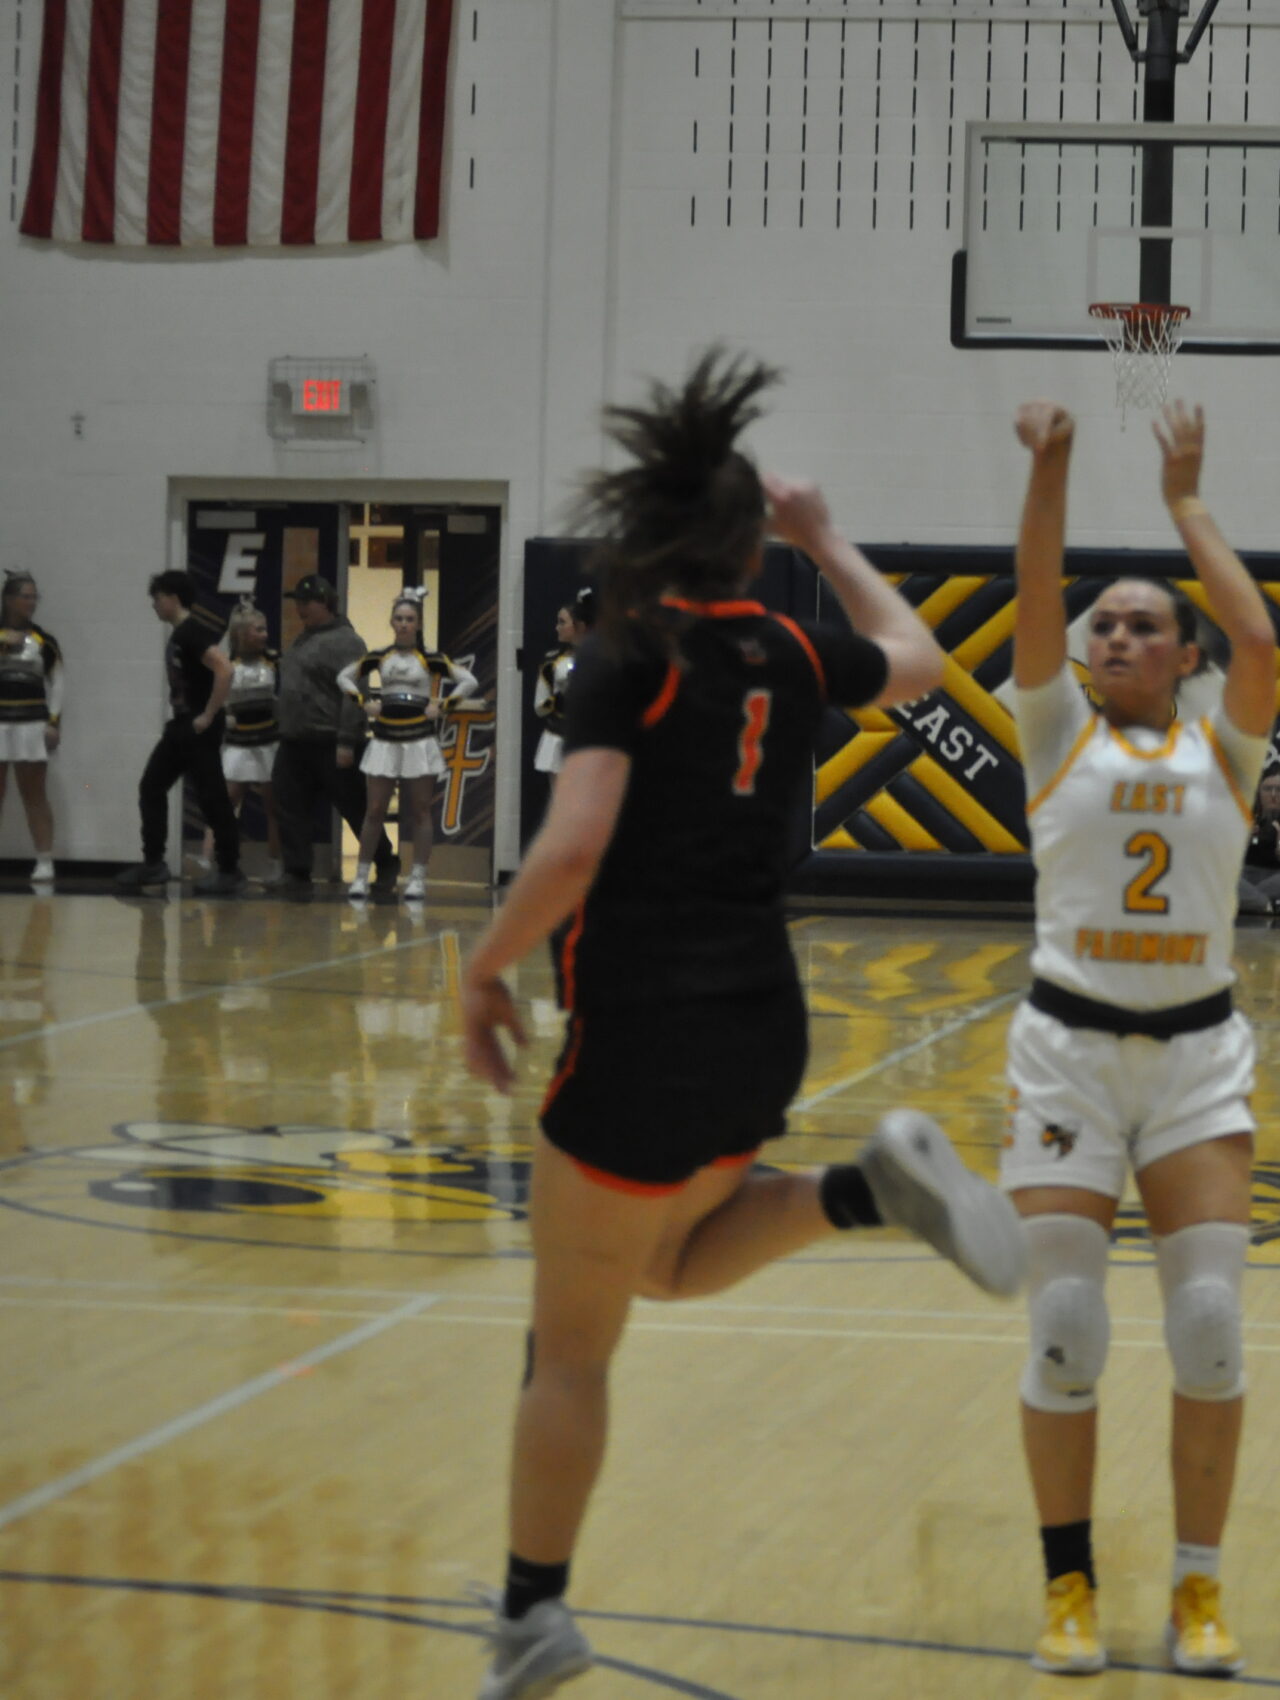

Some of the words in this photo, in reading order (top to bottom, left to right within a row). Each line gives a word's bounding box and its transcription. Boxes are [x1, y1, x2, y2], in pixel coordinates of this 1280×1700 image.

[304, 379, 341, 411] EXIT
[732, 689, 771, 796] 1
[1110, 780, 1186, 815] EAST
[1123, 829, 1171, 914] 2
